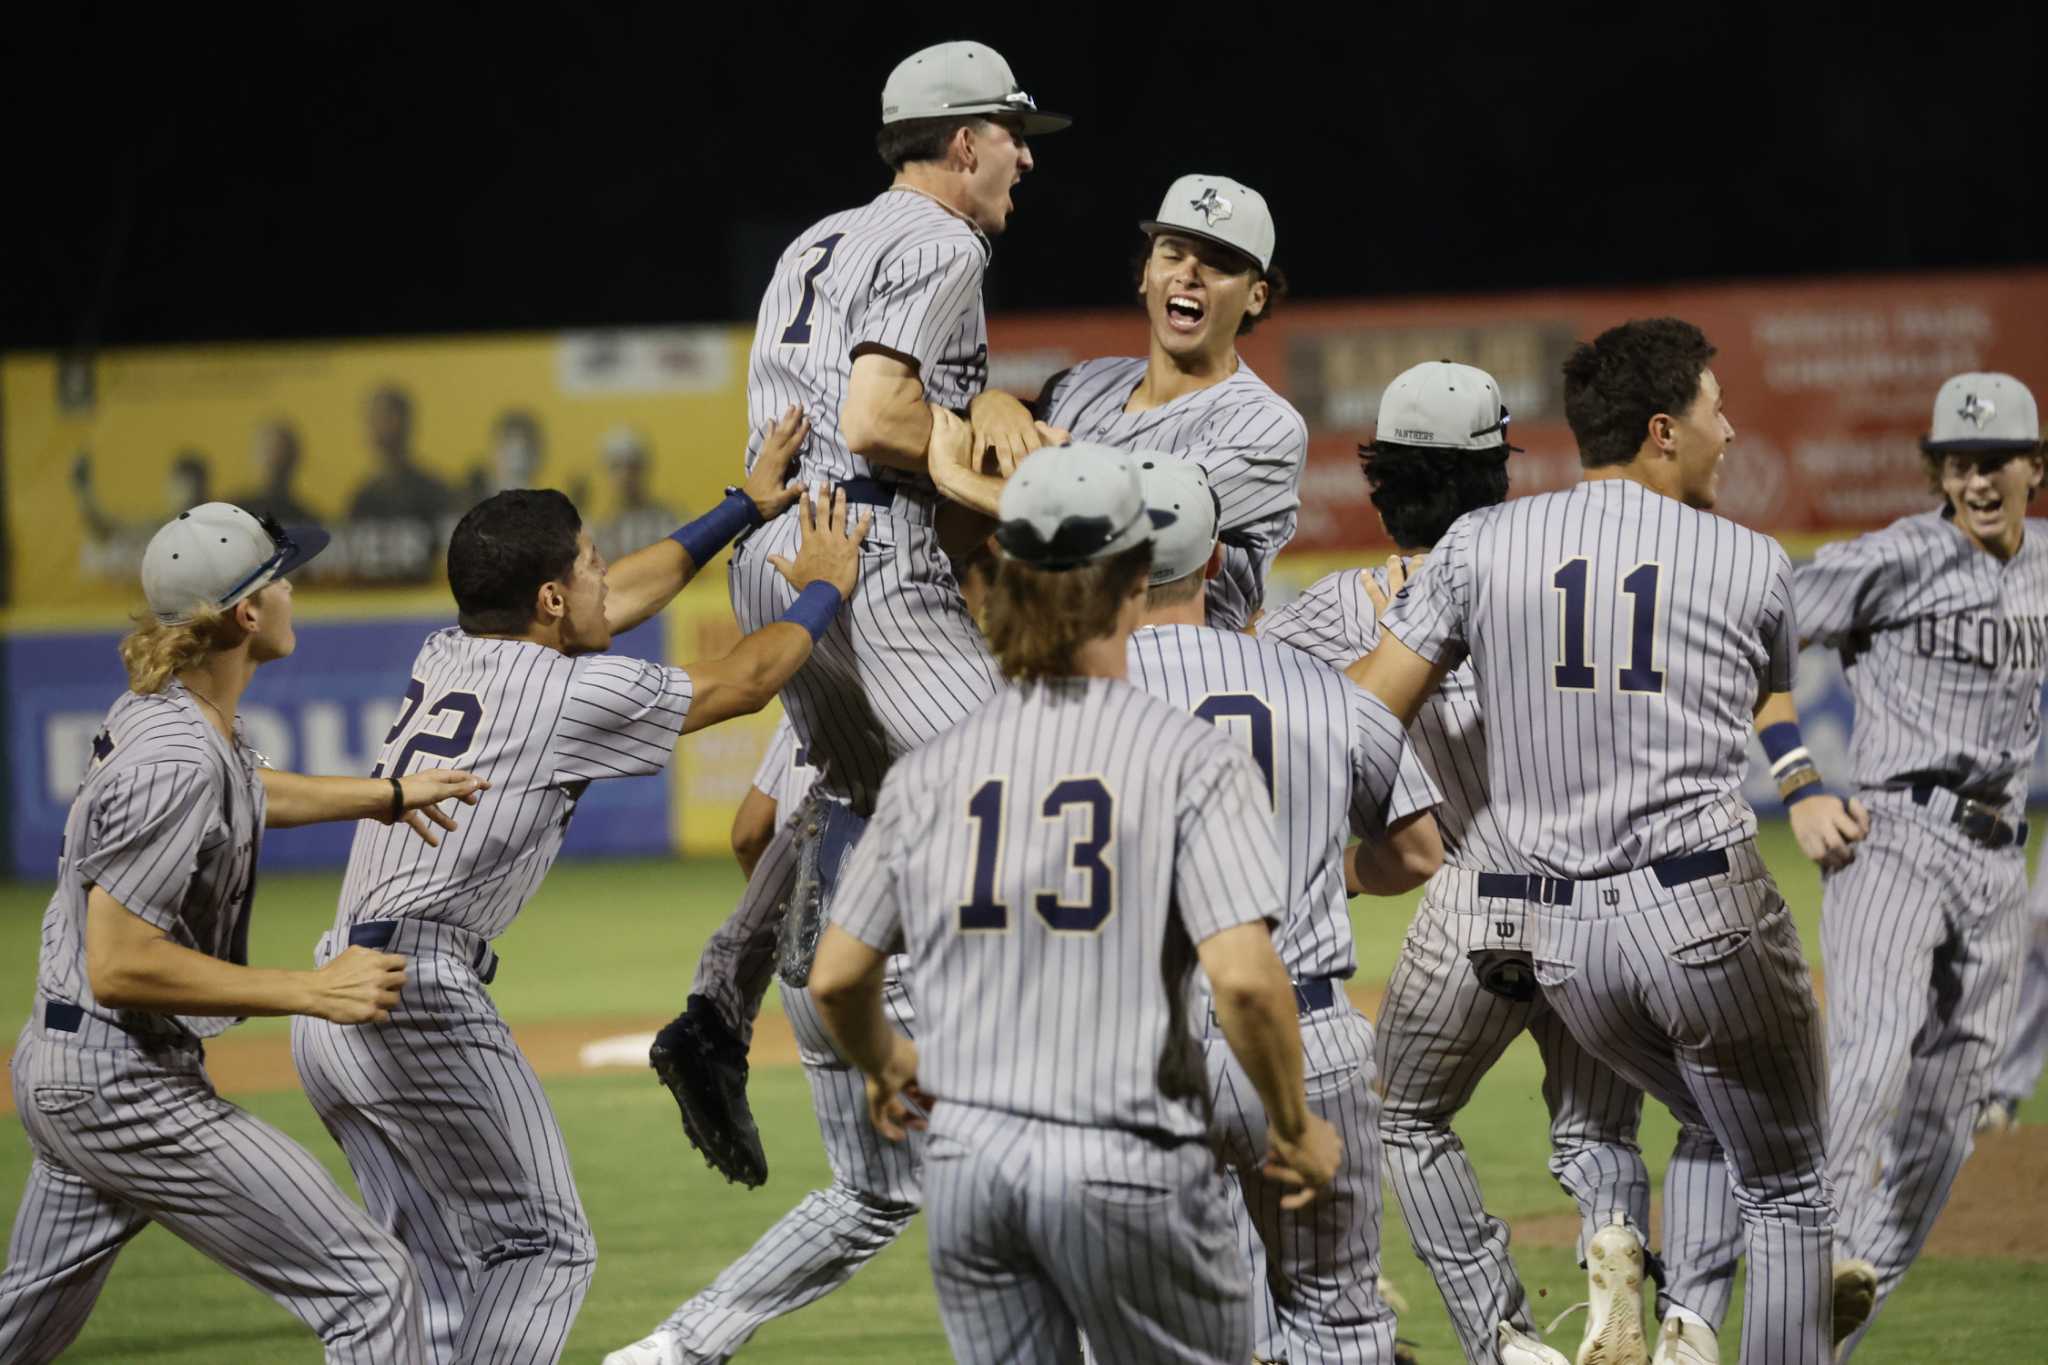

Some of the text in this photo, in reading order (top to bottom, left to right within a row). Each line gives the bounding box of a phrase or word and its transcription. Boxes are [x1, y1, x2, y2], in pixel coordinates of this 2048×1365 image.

[778, 230, 847, 347] 7
[1393, 428, 1435, 440] PANTHERS
[1553, 556, 1667, 694] 11
[955, 775, 1116, 936] 13
